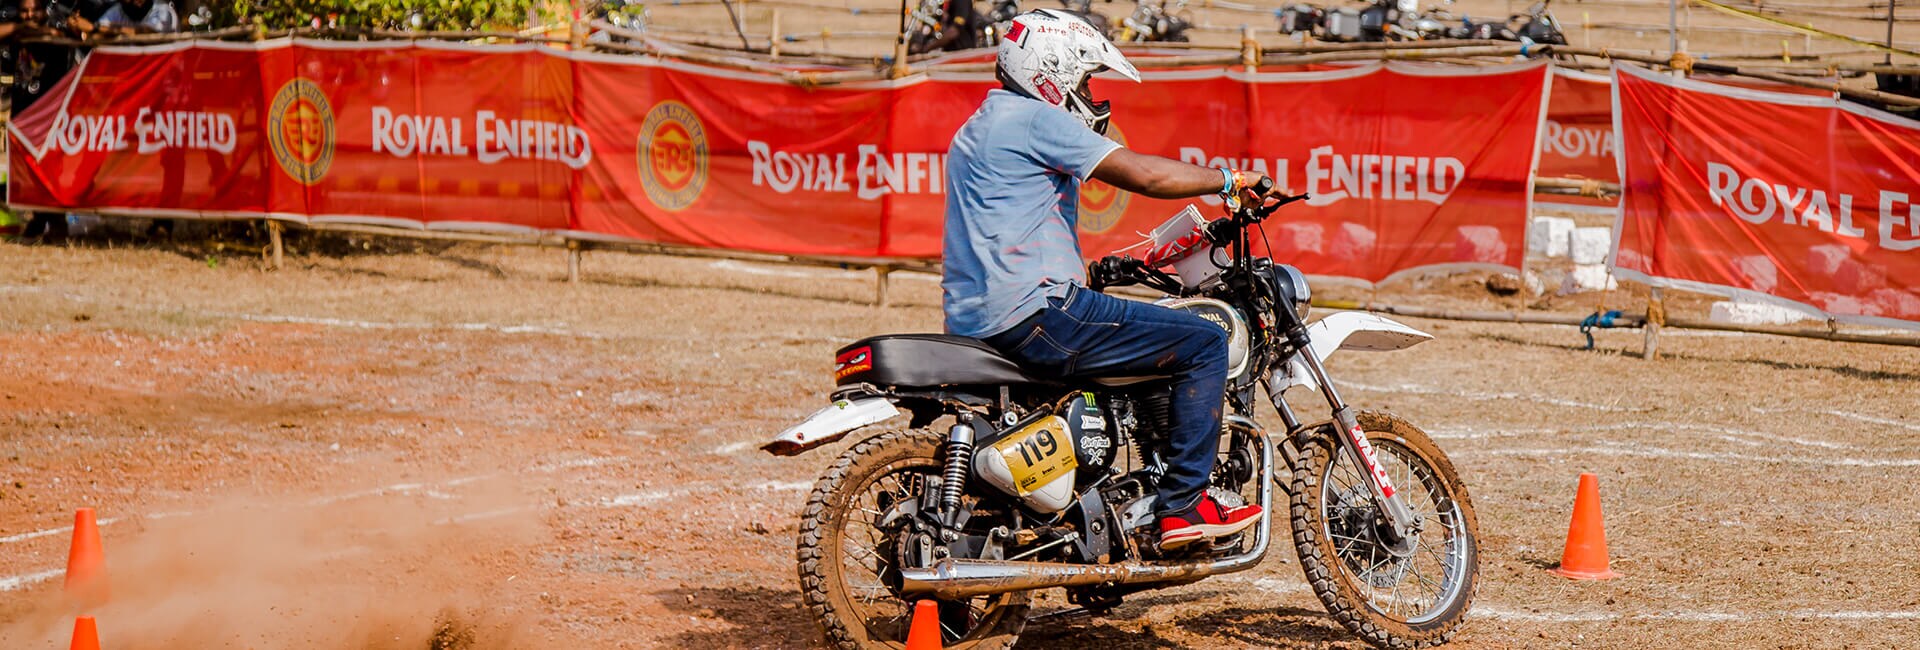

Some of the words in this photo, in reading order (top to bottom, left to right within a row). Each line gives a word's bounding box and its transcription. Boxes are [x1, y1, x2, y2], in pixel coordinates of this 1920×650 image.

[134, 106, 236, 155] ENFIELD
[372, 106, 469, 157] ROYAL
[476, 110, 592, 168] ENFIELD
[747, 140, 850, 193] ROYAL
[857, 144, 948, 200] ENFI
[1305, 145, 1465, 206] ENFIELD
[1707, 162, 1865, 238] ROYAL
[1014, 429, 1058, 468] 119
